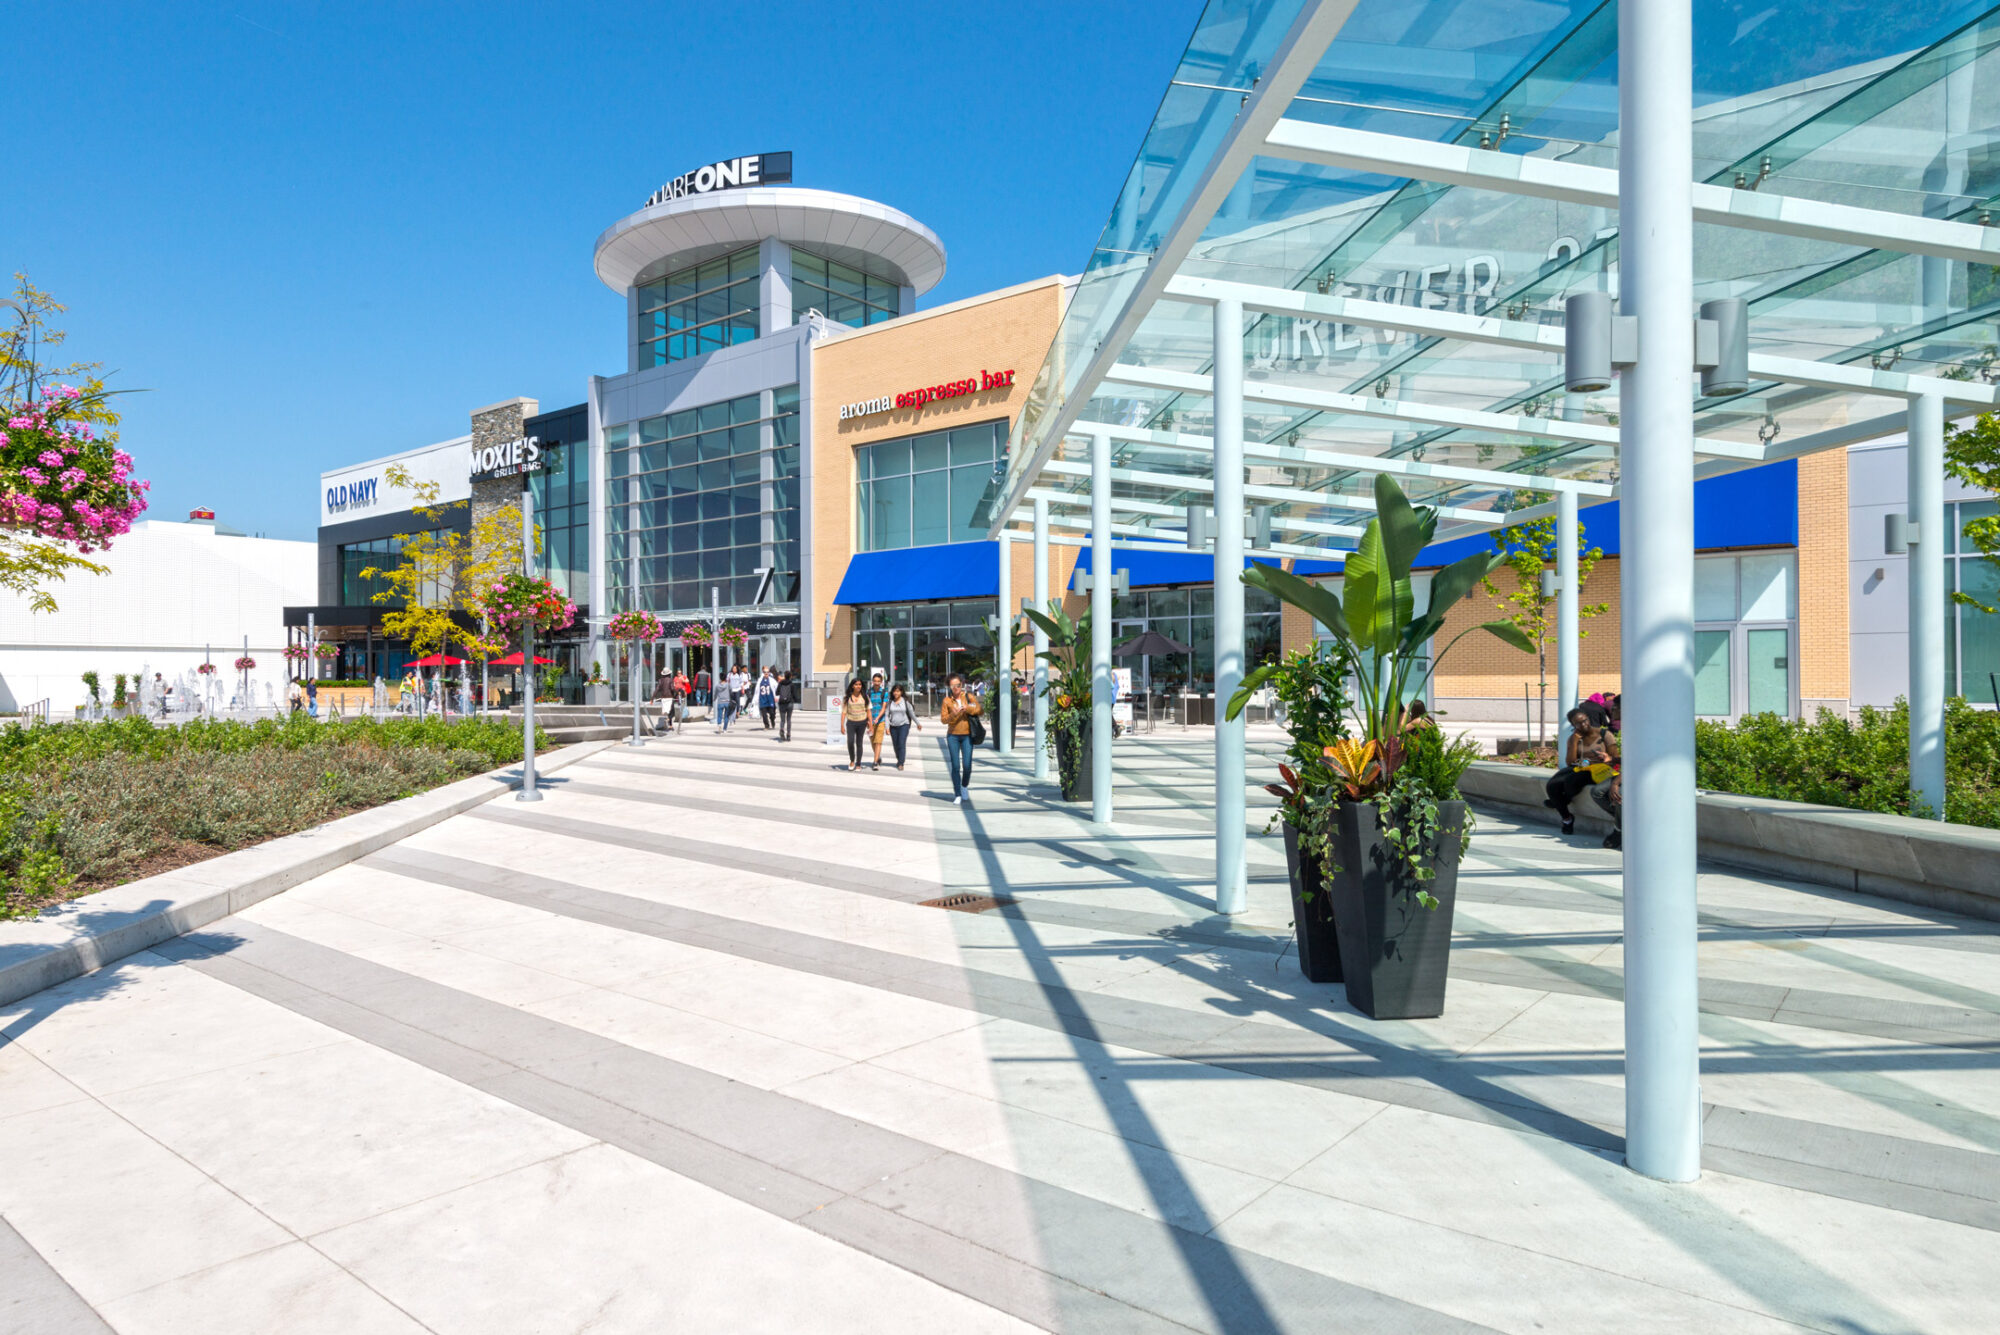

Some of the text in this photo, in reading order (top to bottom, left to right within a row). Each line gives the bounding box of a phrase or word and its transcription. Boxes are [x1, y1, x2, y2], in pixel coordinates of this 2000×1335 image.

[695, 155, 760, 193] ONE
[840, 369, 1015, 420] aroma espresso bar
[469, 436, 539, 474] MOXIE'S
[494, 465, 518, 478] GRILL
[327, 477, 378, 508] OLD NAVY
[753, 568, 775, 605] 7
[756, 620, 788, 631] Entrance 7
[760, 685, 771, 695] 31
